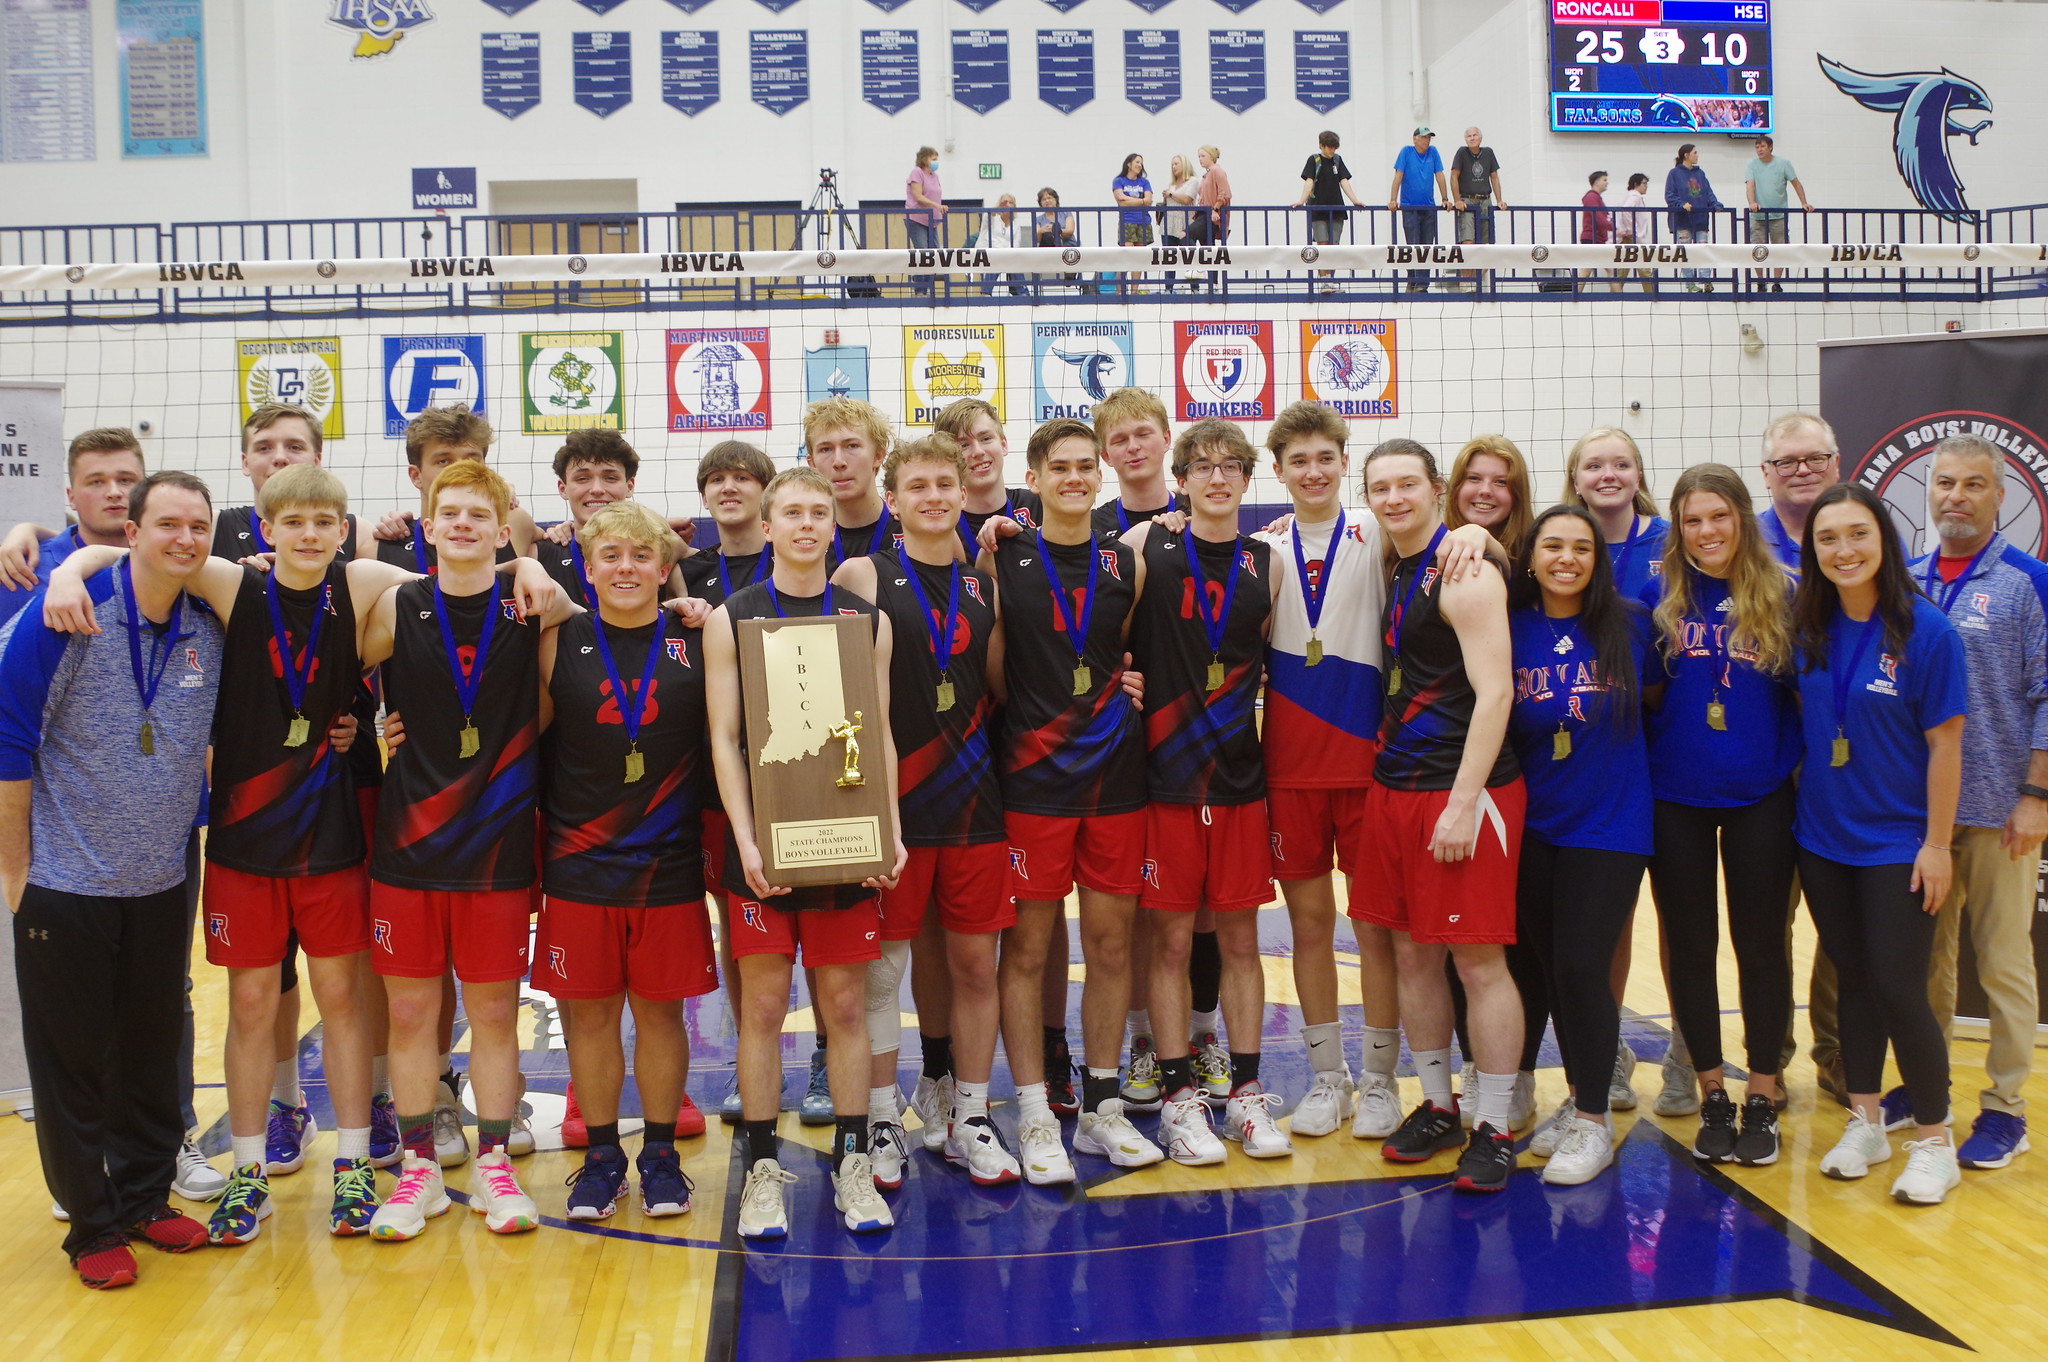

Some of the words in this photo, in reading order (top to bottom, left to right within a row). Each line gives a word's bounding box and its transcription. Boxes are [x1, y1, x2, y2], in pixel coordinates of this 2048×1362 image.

[1556, 1, 1634, 16] RONCALLI
[1734, 5, 1764, 19] HSE
[754, 33, 804, 41] VOLLEYBALL
[1210, 36, 1234, 44] TRACK
[1242, 36, 1264, 44] FIELD
[1302, 34, 1340, 42] SOFTBALL
[1574, 30, 1624, 64] 25
[1656, 41, 1669, 60] 3
[1700, 32, 1748, 66] 10
[1568, 76, 1581, 92] 2
[1744, 78, 1756, 94] 0
[1564, 108, 1642, 123] FALCONS
[980, 164, 1001, 178] EXIT
[416, 194, 474, 206] WOMEN
[907, 248, 992, 268] IBVCA
[1151, 246, 1232, 266] IBVCA
[1386, 245, 1464, 264] IBVCA
[1613, 244, 1689, 263] IBVCA
[1830, 244, 1903, 262] IBVCA
[409, 257, 495, 277] IBVCA
[660, 253, 744, 272] IBVCA
[159, 262, 244, 282] IBVCA
[670, 330, 766, 344] MARTINSVILLE
[914, 328, 995, 340] MOORESVILLE
[1037, 326, 1072, 337] PERRY
[1075, 325, 1127, 336] MERIDIAN
[1187, 324, 1260, 336] PLAINFIELD
[1310, 324, 1386, 335] WHITELAND
[242, 343, 288, 356] DECATUR
[290, 341, 337, 354] CENTRAL
[400, 338, 466, 351] FRANKLIN
[1206, 348, 1220, 356] RED
[1222, 348, 1242, 356] PRIDE
[928, 364, 983, 377] MOORESVILLE
[1186, 401, 1262, 418] QUAKERS
[1317, 399, 1392, 415] RRIORS
[674, 412, 766, 429] ARTESIANS
[790, 838, 814, 846] STATE
[816, 835, 864, 844] CHAMPIONS
[785, 850, 808, 858] BOYS
[810, 846, 870, 857] VOLLEYBALL
